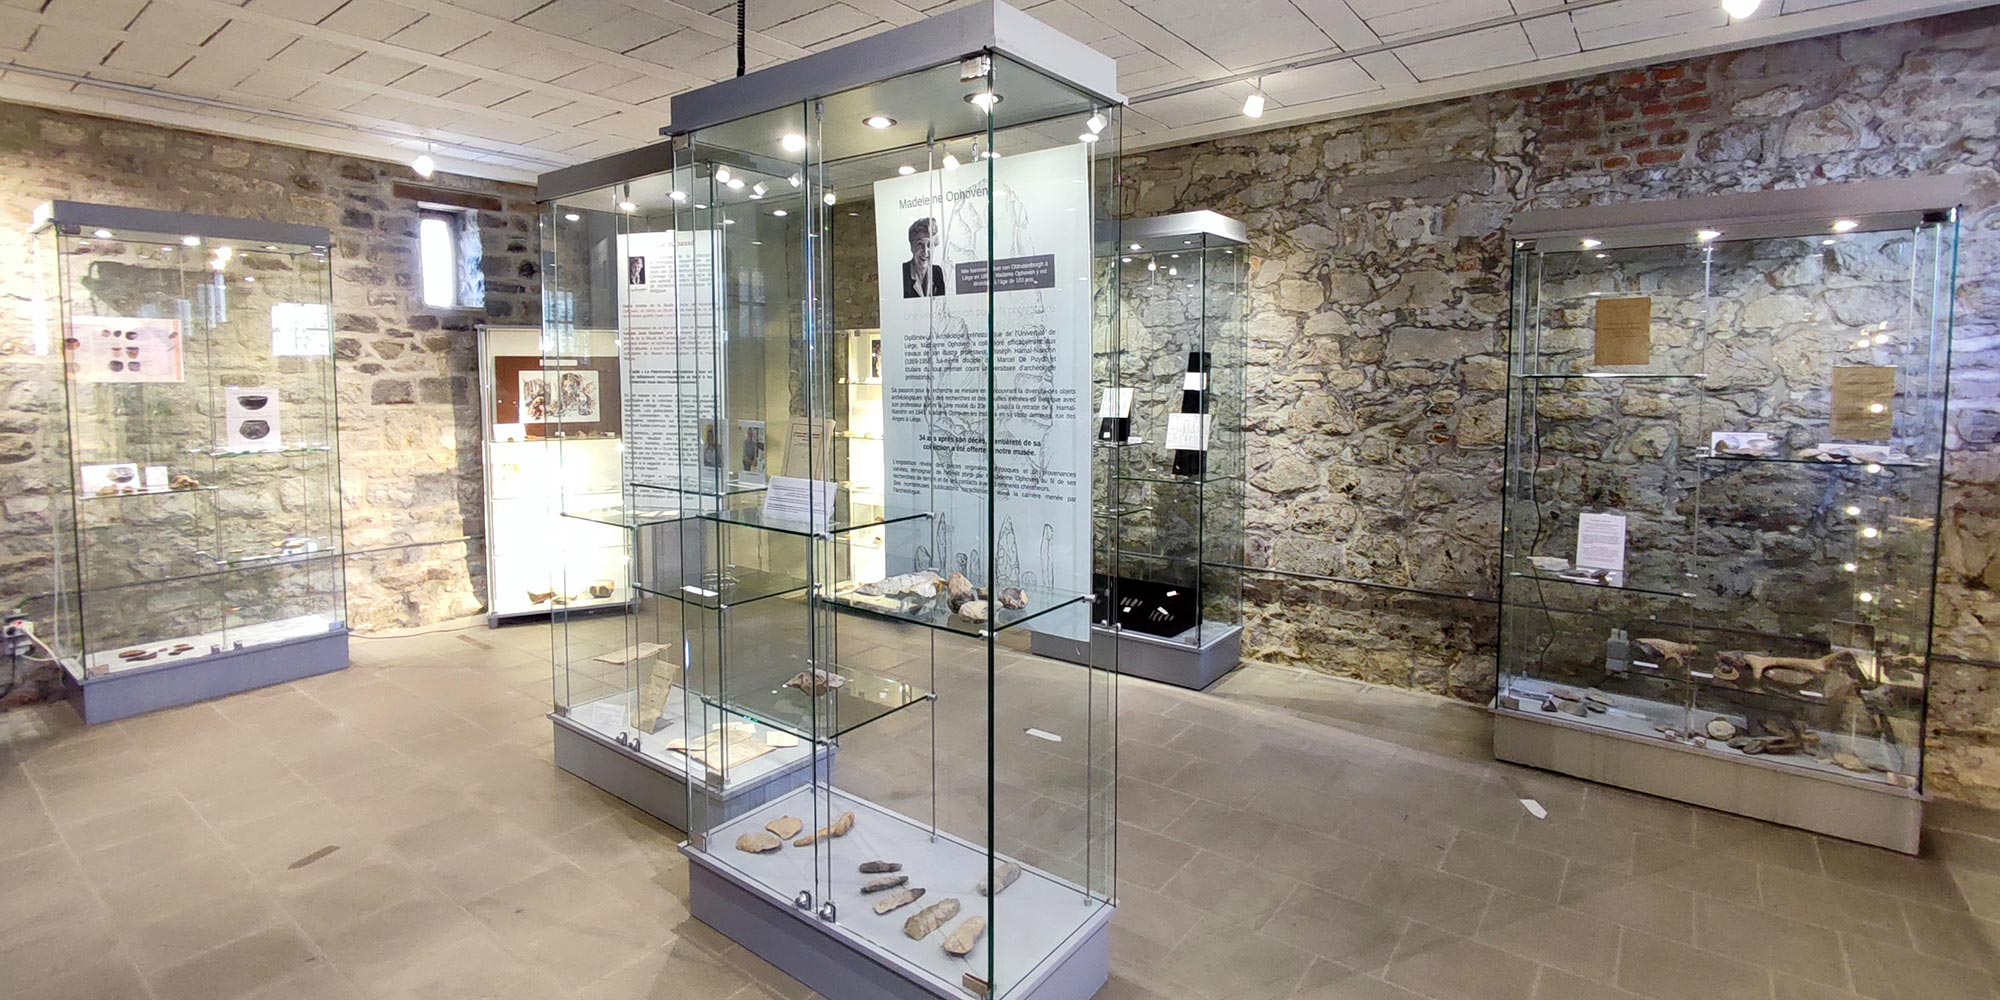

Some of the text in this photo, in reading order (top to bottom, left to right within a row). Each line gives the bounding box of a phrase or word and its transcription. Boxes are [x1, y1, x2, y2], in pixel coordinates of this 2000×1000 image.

[899, 186, 989, 209] Madelene Ophoven
[1059, 388, 1076, 396] objets
[938, 435, 954, 443] après
[966, 445, 986, 453] offerte
[1042, 470, 1076, 478] provenances
